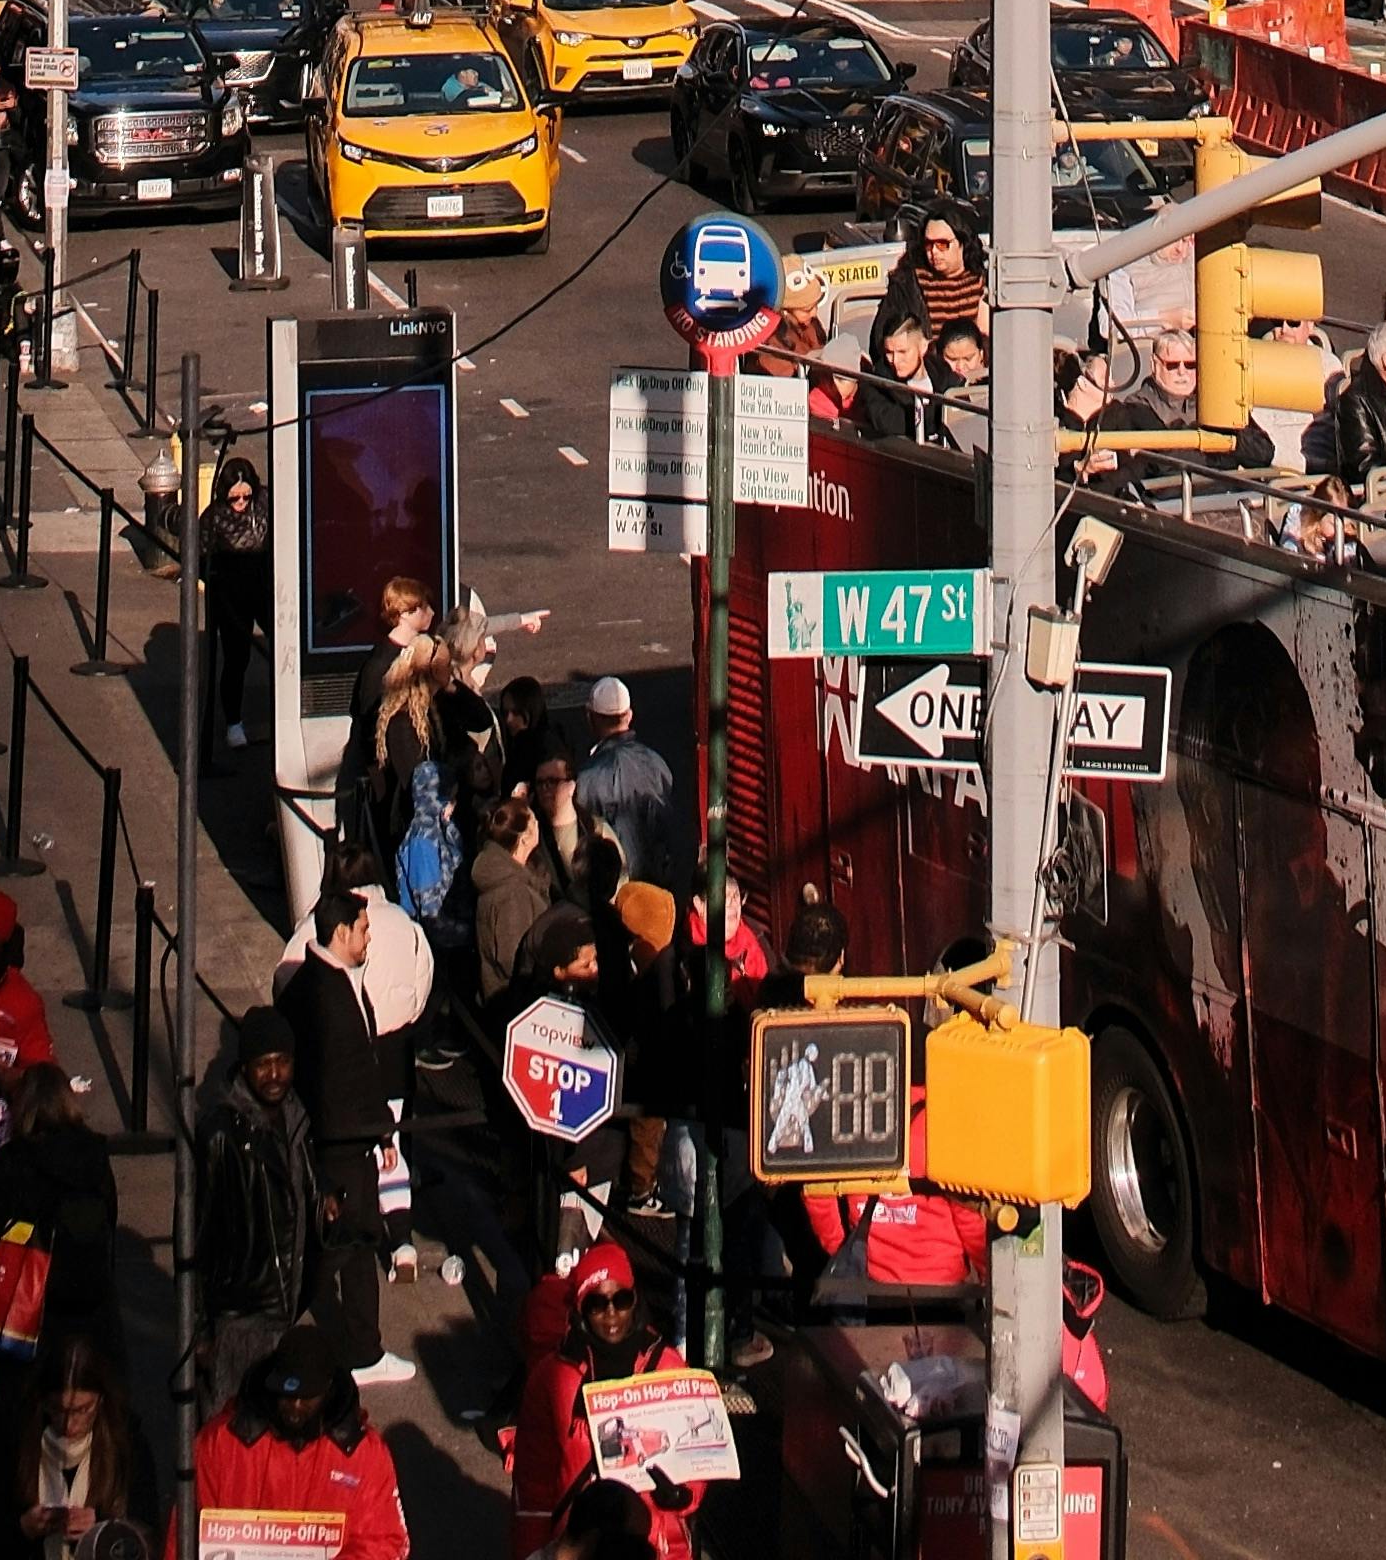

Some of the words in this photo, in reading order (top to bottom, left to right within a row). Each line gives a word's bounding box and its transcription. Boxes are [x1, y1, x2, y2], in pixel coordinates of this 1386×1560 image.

[839, 265, 878, 282] SEATED
[673, 310, 691, 331] NO
[694, 311, 769, 346] STANDING
[616, 376, 633, 389] Pick
[635, 378, 670, 391] Up/Drop
[686, 380, 704, 394] Only
[740, 383, 756, 398] Gray
[758, 383, 772, 397] Line
[740, 401, 755, 413] New
[756, 401, 772, 414] York
[616, 416, 633, 429] Pick
[635, 418, 670, 433] Up/Drop
[672, 419, 683, 432] Off
[685, 421, 703, 435] Only
[740, 426, 759, 439] New
[762, 427, 783, 440] York
[740, 442, 766, 456] Iconic
[768, 443, 804, 457] Cruises
[615, 458, 633, 471] Pick
[635, 459, 669, 474] Up/Drop
[671, 461, 682, 473] Off
[685, 463, 703, 478] Only
[740, 466, 759, 481] Top
[763, 468, 789, 483] View
[740, 483, 804, 504] Sightseeing
[615, 504, 621, 516] 7
[627, 505, 641, 518] Av
[646, 506, 654, 519] &
[615, 520, 627, 533] W
[631, 521, 646, 534] 47
[650, 523, 663, 536] St
[837, 585, 870, 646] W
[880, 585, 933, 645] 47
[941, 584, 967, 622] St
[528, 1055, 591, 1094] STOP
[549, 1089, 563, 1125] 1
[593, 1387, 642, 1410] Hop-On
[644, 1382, 691, 1404] Hop-Off
[692, 1378, 720, 1398] Pass
[207, 1523, 261, 1544] Hop-On
[264, 1523, 315, 1544] Hop-Off
[317, 1524, 340, 1541] Pass
